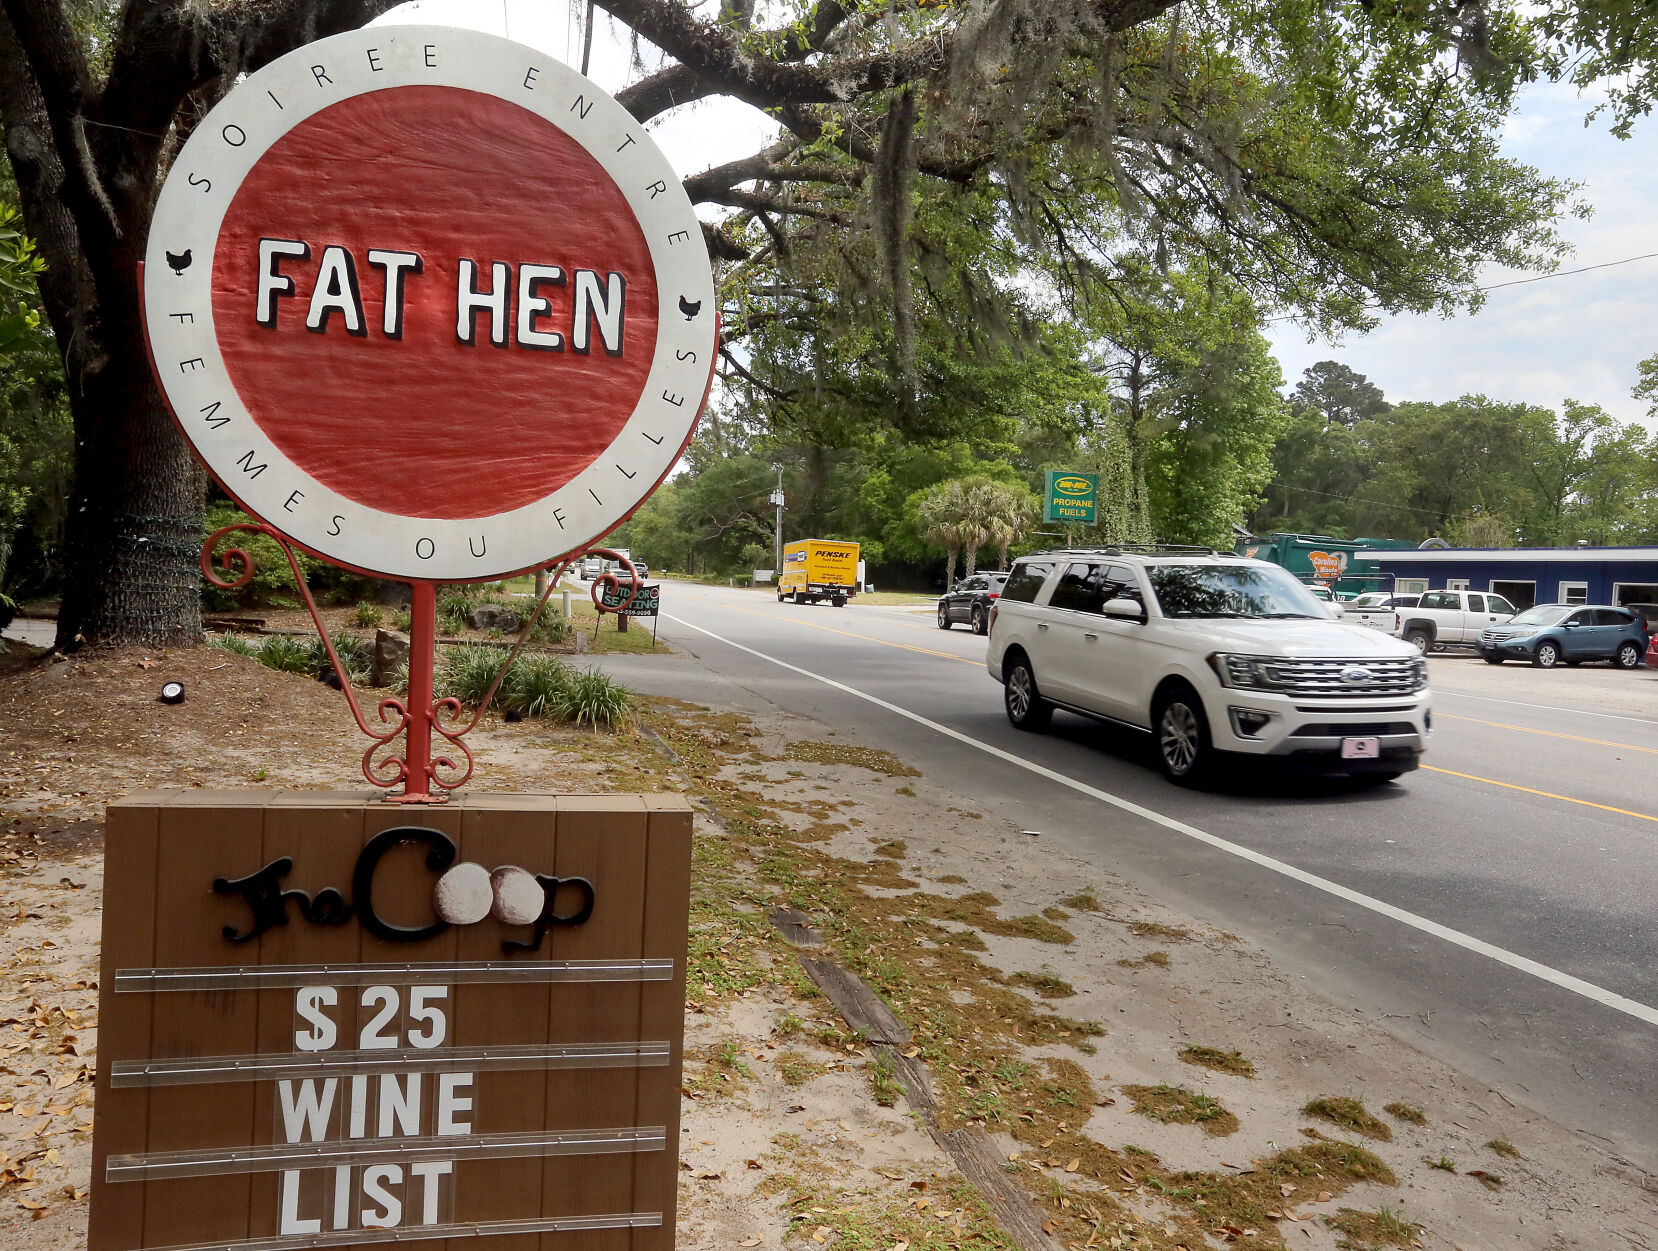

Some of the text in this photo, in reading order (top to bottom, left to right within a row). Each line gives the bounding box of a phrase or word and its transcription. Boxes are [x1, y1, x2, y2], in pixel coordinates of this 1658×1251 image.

[188, 44, 691, 247] SOIREE ENTRE
[255, 237, 626, 357] FAT HEN
[169, 312, 698, 560] FEMMES OU FILLES
[1053, 498, 1093, 508] PROPANE
[1059, 508, 1086, 517] FUELS
[815, 550, 851, 559] PENSKE
[212, 826, 595, 951] The Coop
[278, 1072, 474, 1144] WINE
[280, 1160, 453, 1236] LIST
